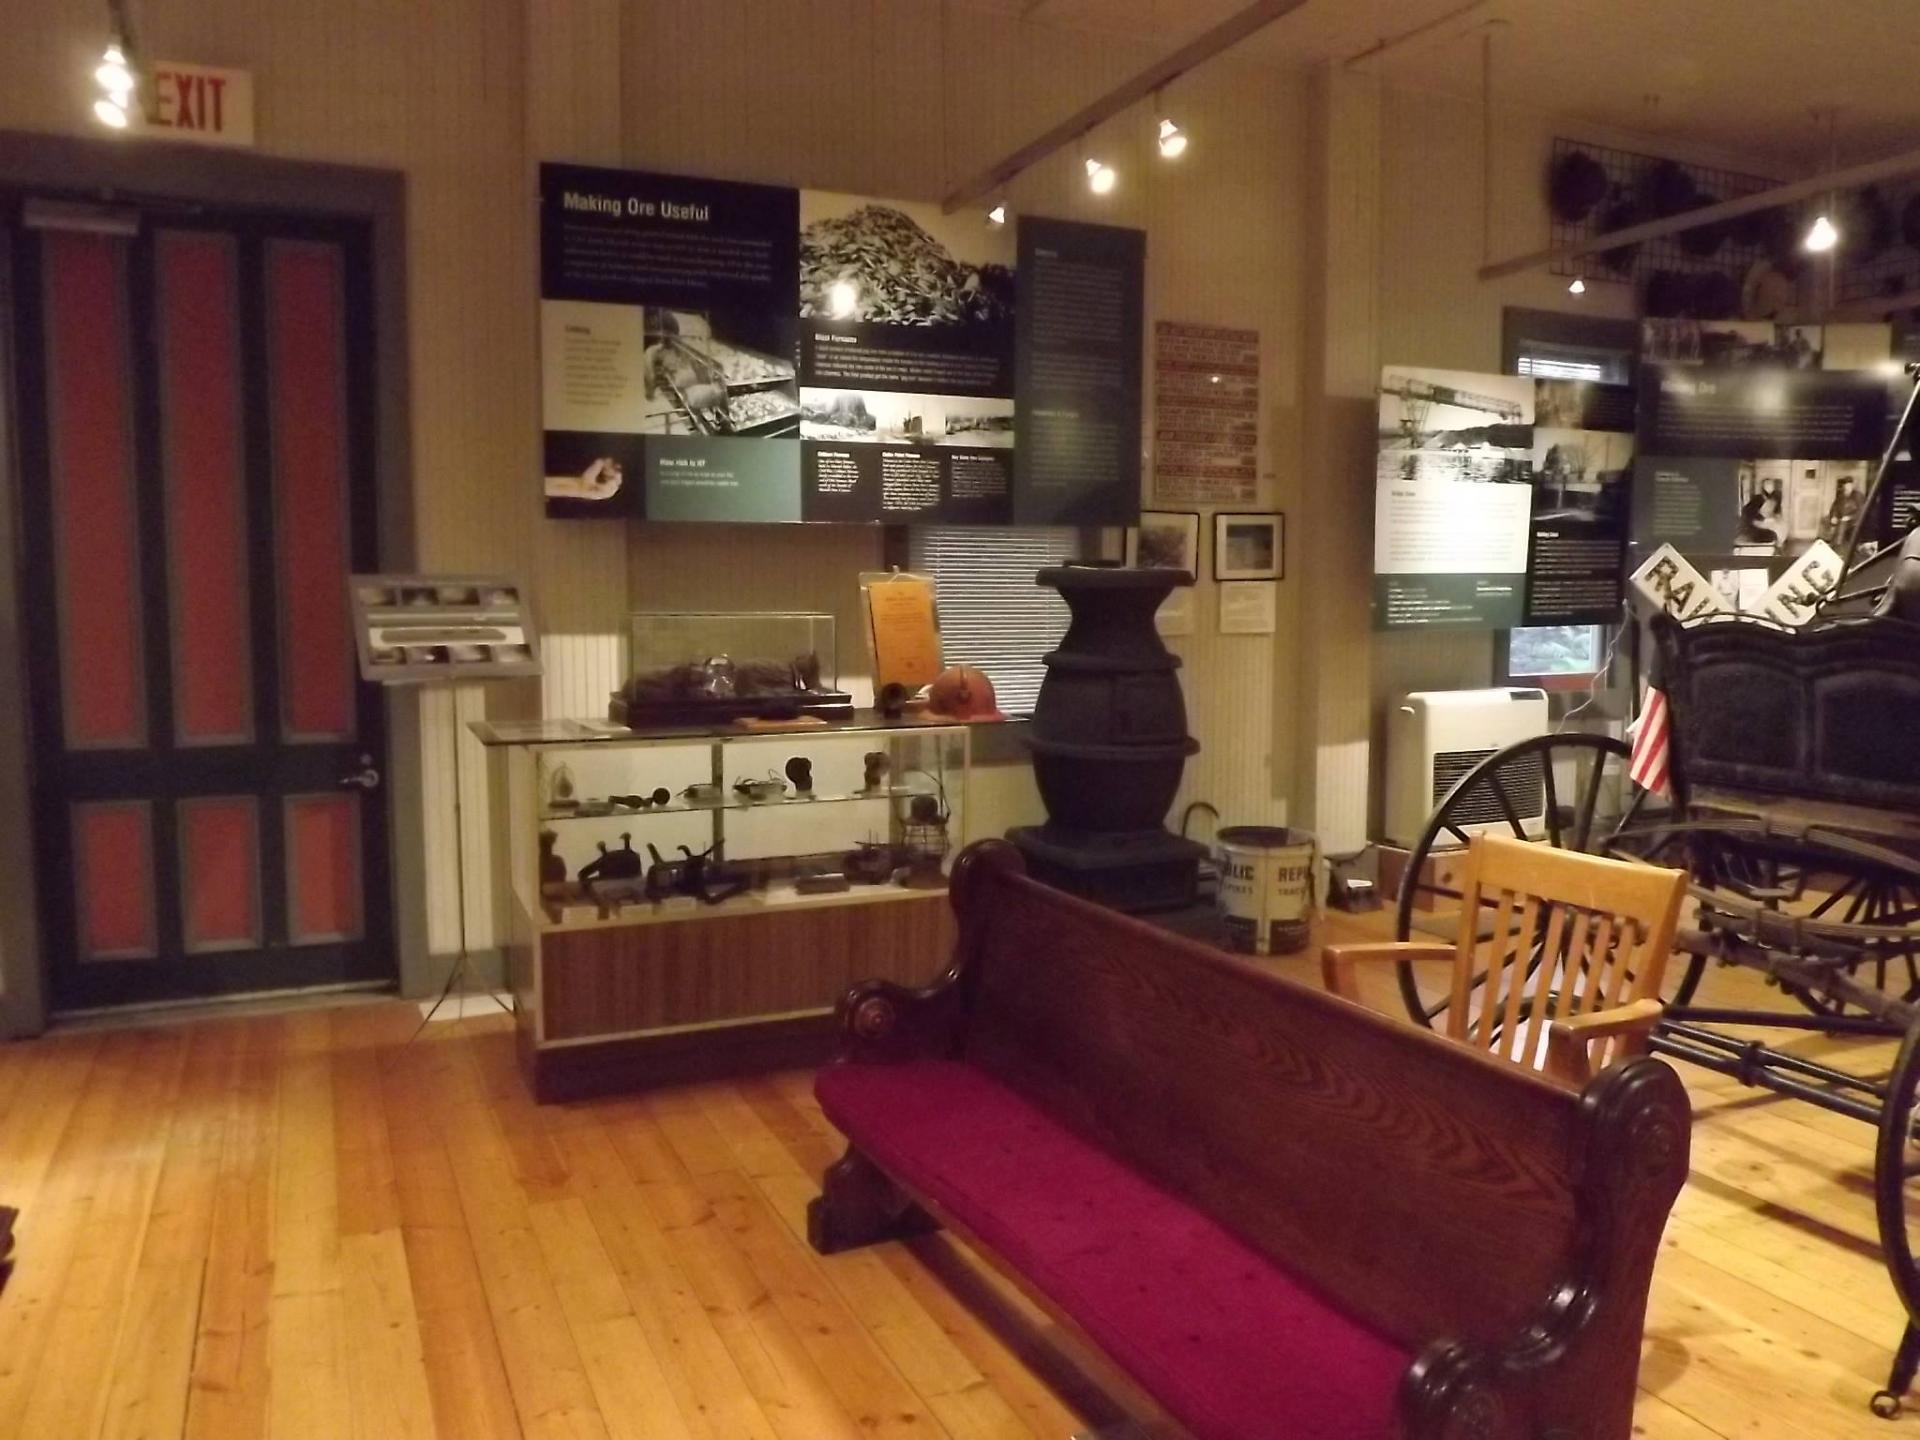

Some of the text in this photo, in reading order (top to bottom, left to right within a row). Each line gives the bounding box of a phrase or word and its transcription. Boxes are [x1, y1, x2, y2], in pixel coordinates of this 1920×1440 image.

[147, 71, 227, 133] EXIT
[563, 191, 710, 222] Making Ore Useful
